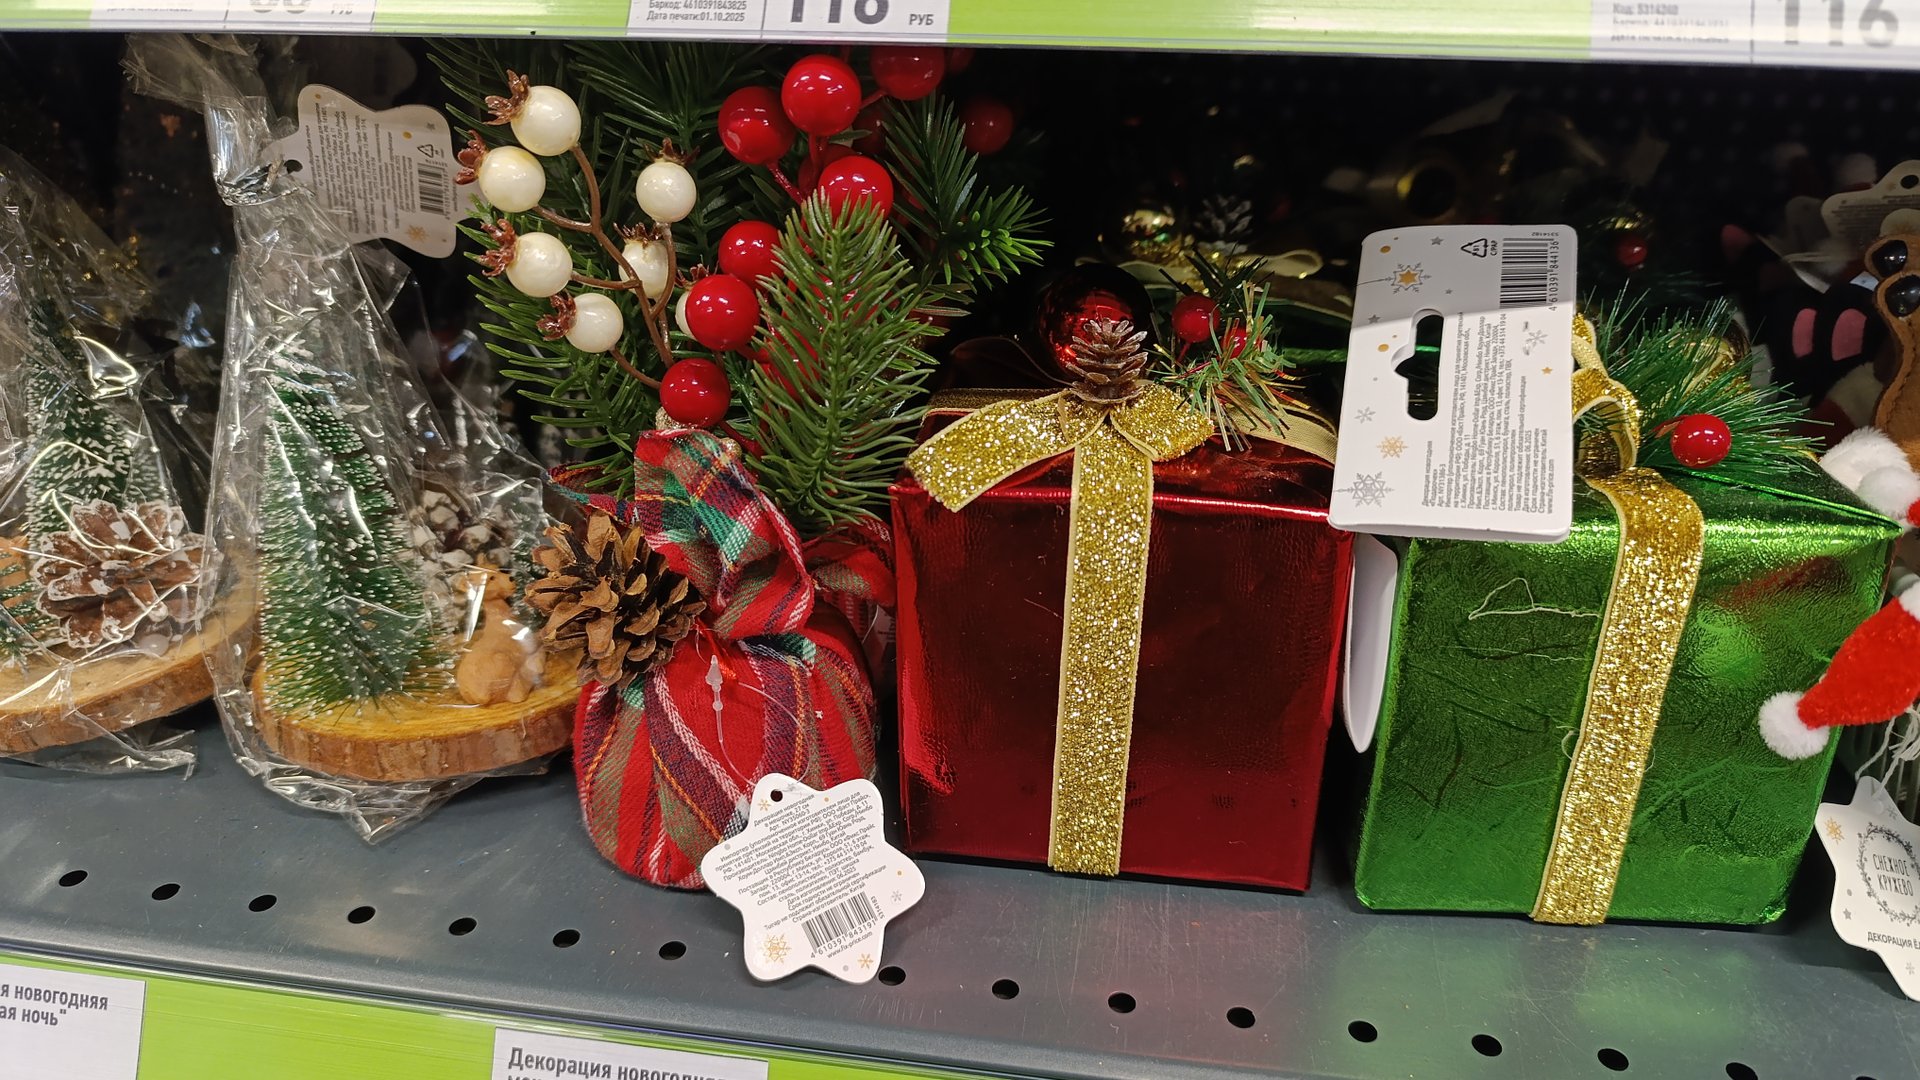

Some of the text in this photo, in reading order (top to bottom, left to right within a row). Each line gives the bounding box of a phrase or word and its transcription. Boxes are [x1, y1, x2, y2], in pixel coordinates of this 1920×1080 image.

[646, 10, 668, 20] Дата
[908, 14, 934, 26] РУБ
[1872, 854, 1910, 876] СНЕЖНОЕ
[1878, 874, 1913, 896] КРУЖЕВО
[1867, 932, 1912, 949] ДЕКОРАЦИЯ
[14, 986, 108, 1010] новогодняя
[22, 1008, 66, 1026] ночь"
[508, 1046, 612, 1080] Декорация
